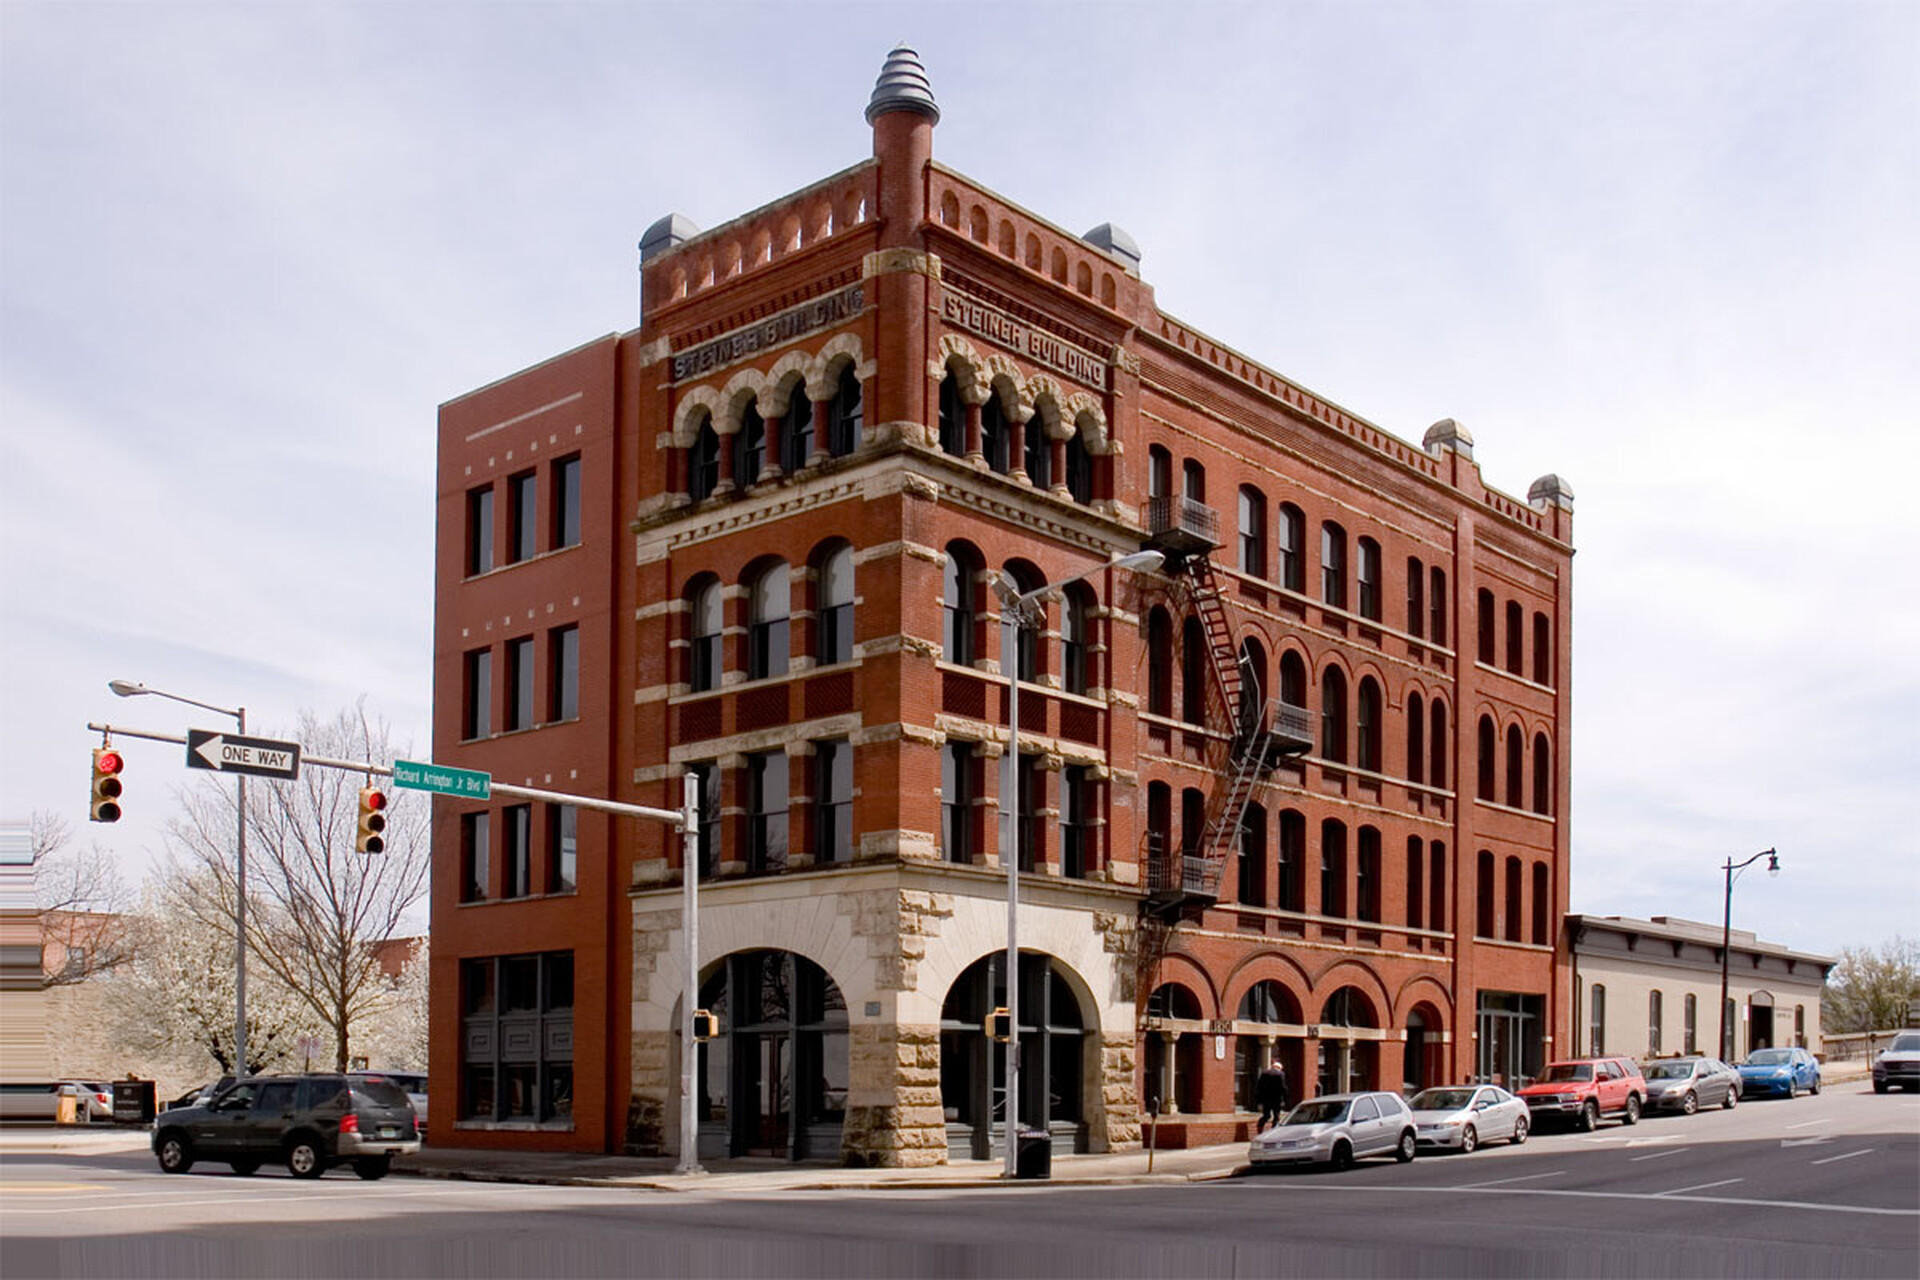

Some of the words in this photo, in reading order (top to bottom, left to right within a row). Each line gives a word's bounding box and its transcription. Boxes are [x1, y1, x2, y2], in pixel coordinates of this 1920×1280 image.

[674, 332, 760, 379] STEINER
[764, 289, 865, 345] BUILDING
[944, 296, 1021, 348] STEINER
[1028, 331, 1101, 386] BUILDING
[222, 745, 251, 763] ONE
[258, 751, 287, 767] WAY
[396, 766, 420, 783] Richard
[424, 770, 453, 791] Arrington
[466, 776, 481, 792] Blvd
